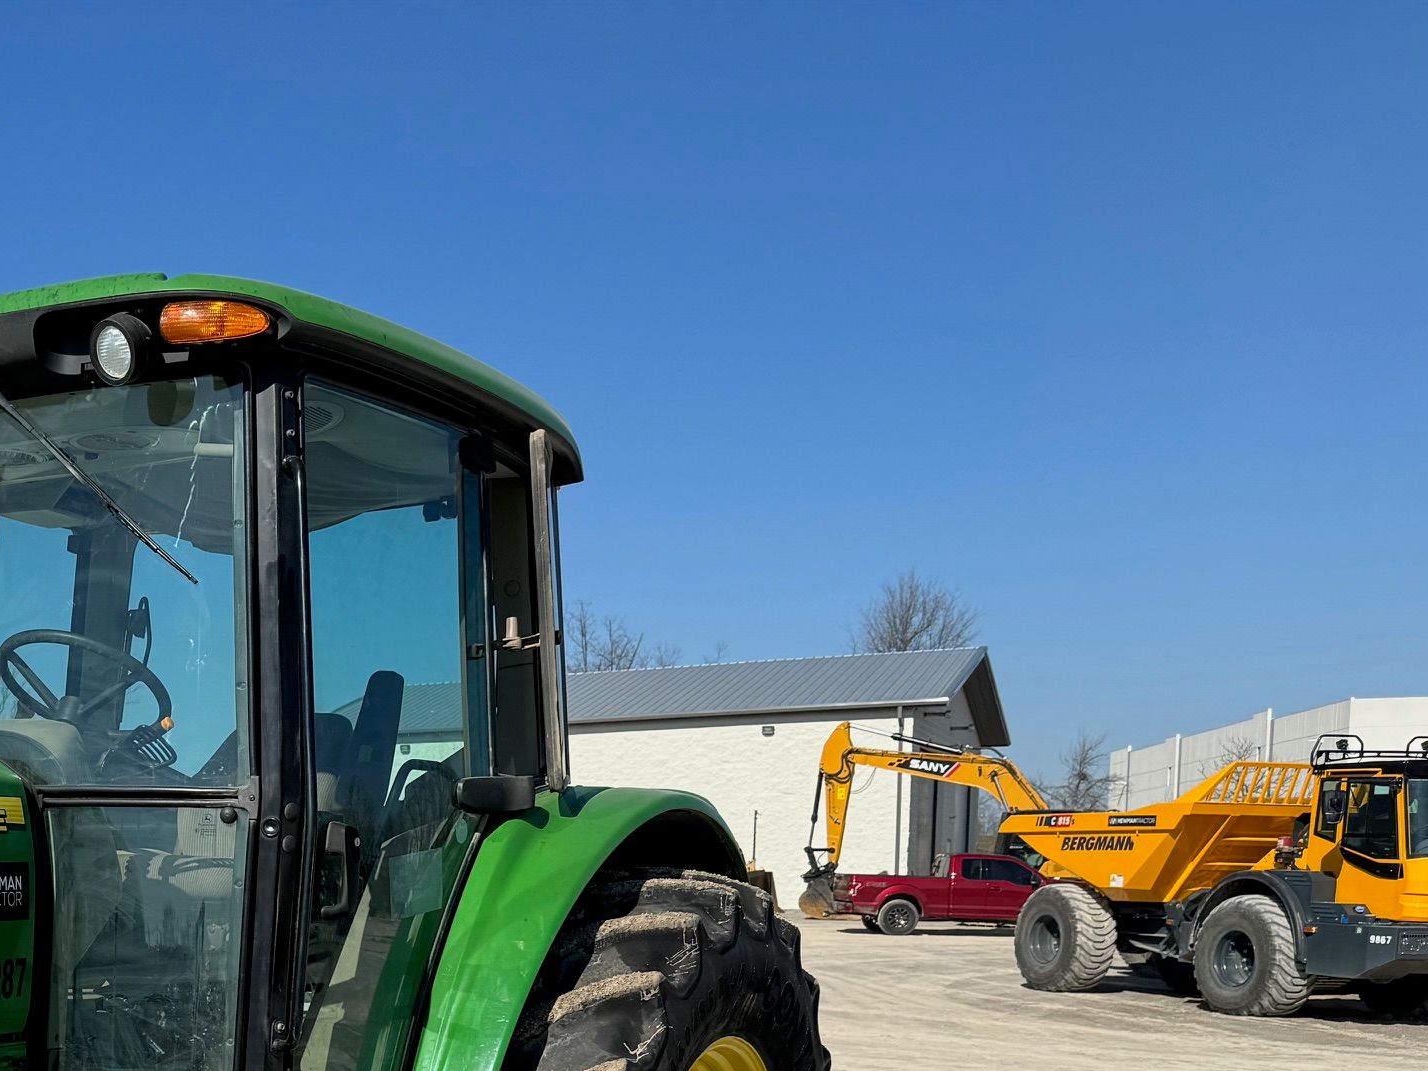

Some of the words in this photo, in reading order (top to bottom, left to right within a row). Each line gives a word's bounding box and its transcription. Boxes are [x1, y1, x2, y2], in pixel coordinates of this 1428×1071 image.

[909, 758, 950, 774] SANY
[1061, 836, 1135, 851] BERGMANN
[1369, 935, 1392, 945] 9867
